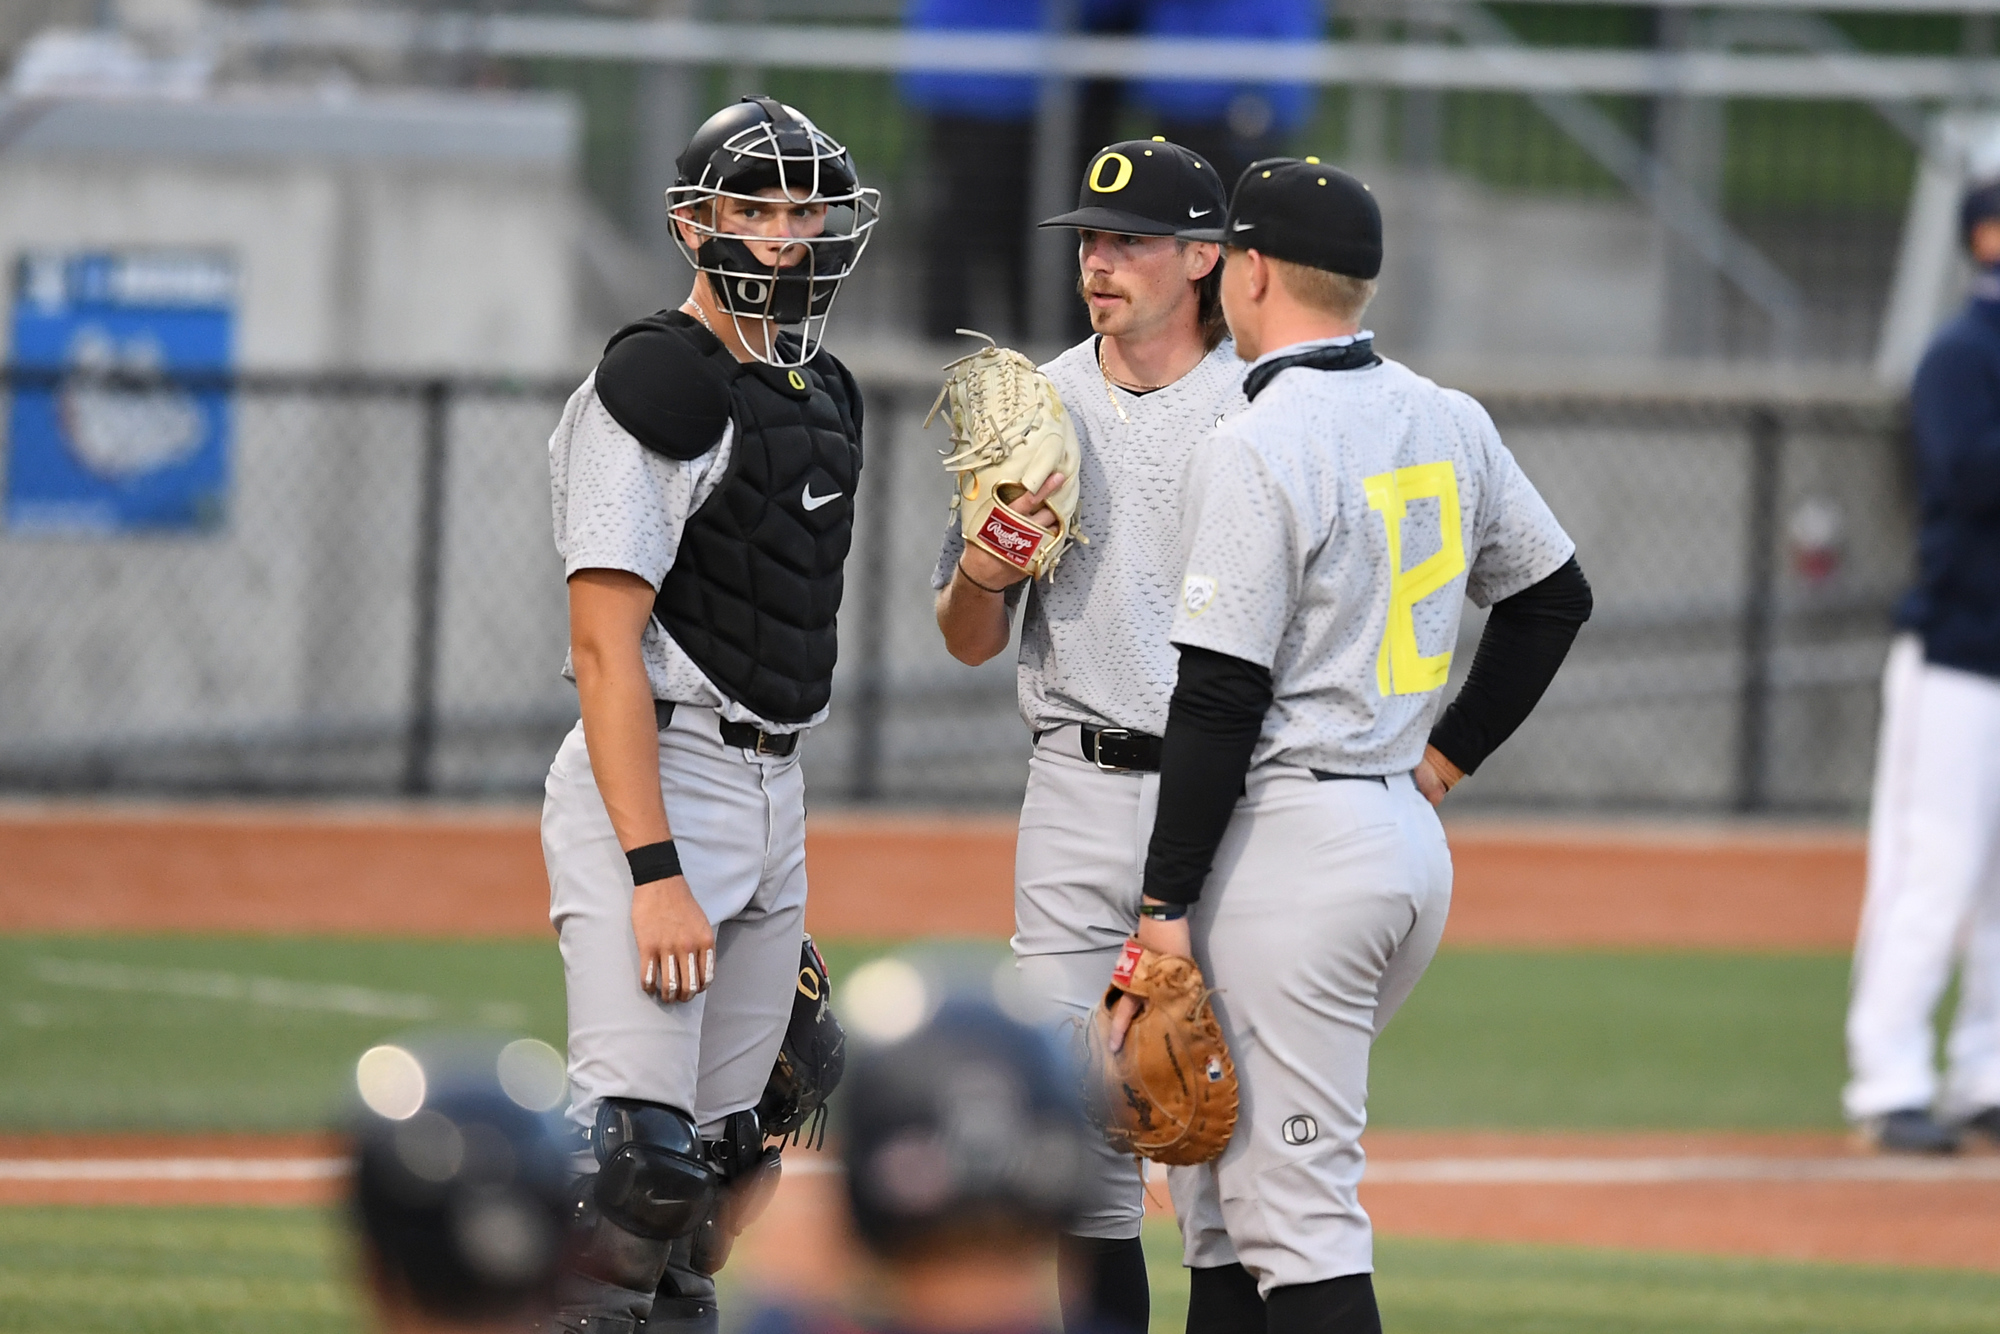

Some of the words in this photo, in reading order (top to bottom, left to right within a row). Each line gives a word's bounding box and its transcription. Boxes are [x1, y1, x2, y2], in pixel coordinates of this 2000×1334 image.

[1089, 152, 1133, 193] O
[737, 279, 768, 304] O
[987, 521, 1033, 550] Rawlings
[1282, 1114, 1318, 1146] O
